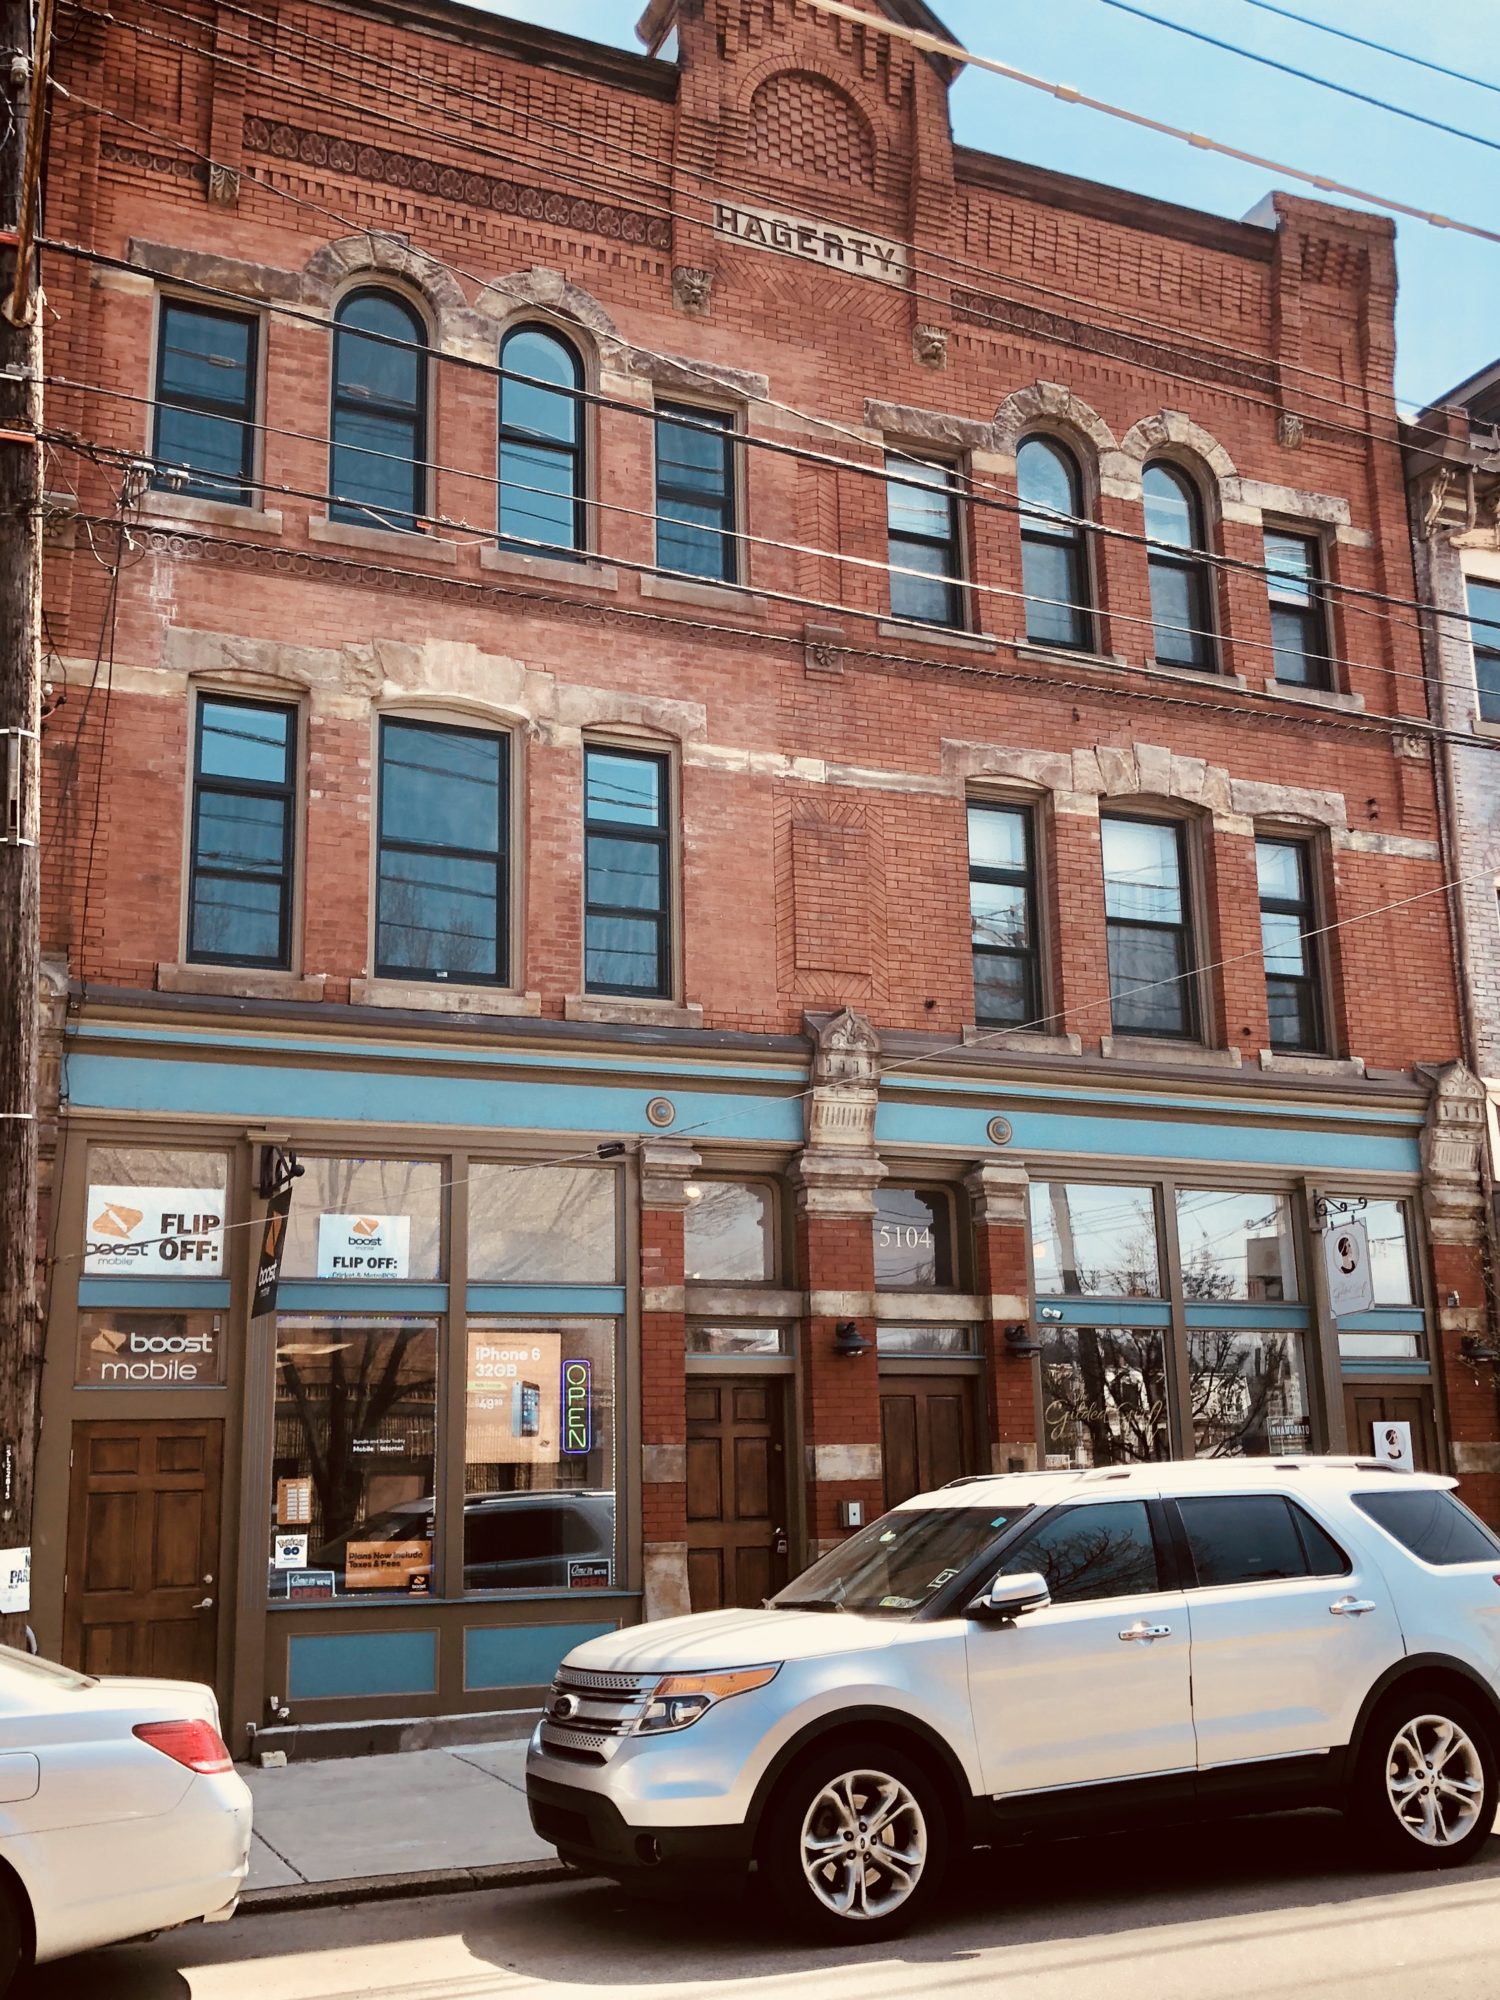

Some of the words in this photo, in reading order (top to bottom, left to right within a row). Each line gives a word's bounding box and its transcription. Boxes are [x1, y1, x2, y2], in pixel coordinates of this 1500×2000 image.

[160, 1213, 220, 1234] FLIP
[348, 1236, 382, 1246] boost
[880, 1225, 932, 1249] 5104
[159, 1240, 218, 1261] OFF:
[333, 1256, 363, 1268] FLIP
[367, 1257, 397, 1269] OFF:
[258, 1259, 278, 1287] boost
[130, 1332, 213, 1353] boost
[475, 1347, 528, 1361] iPhone
[531, 1347, 541, 1361] 6
[101, 1360, 197, 1380] mobile
[475, 1363, 517, 1377] 32GB
[566, 1364, 587, 1449] OPEN
[572, 1576, 607, 1588] OPEN
